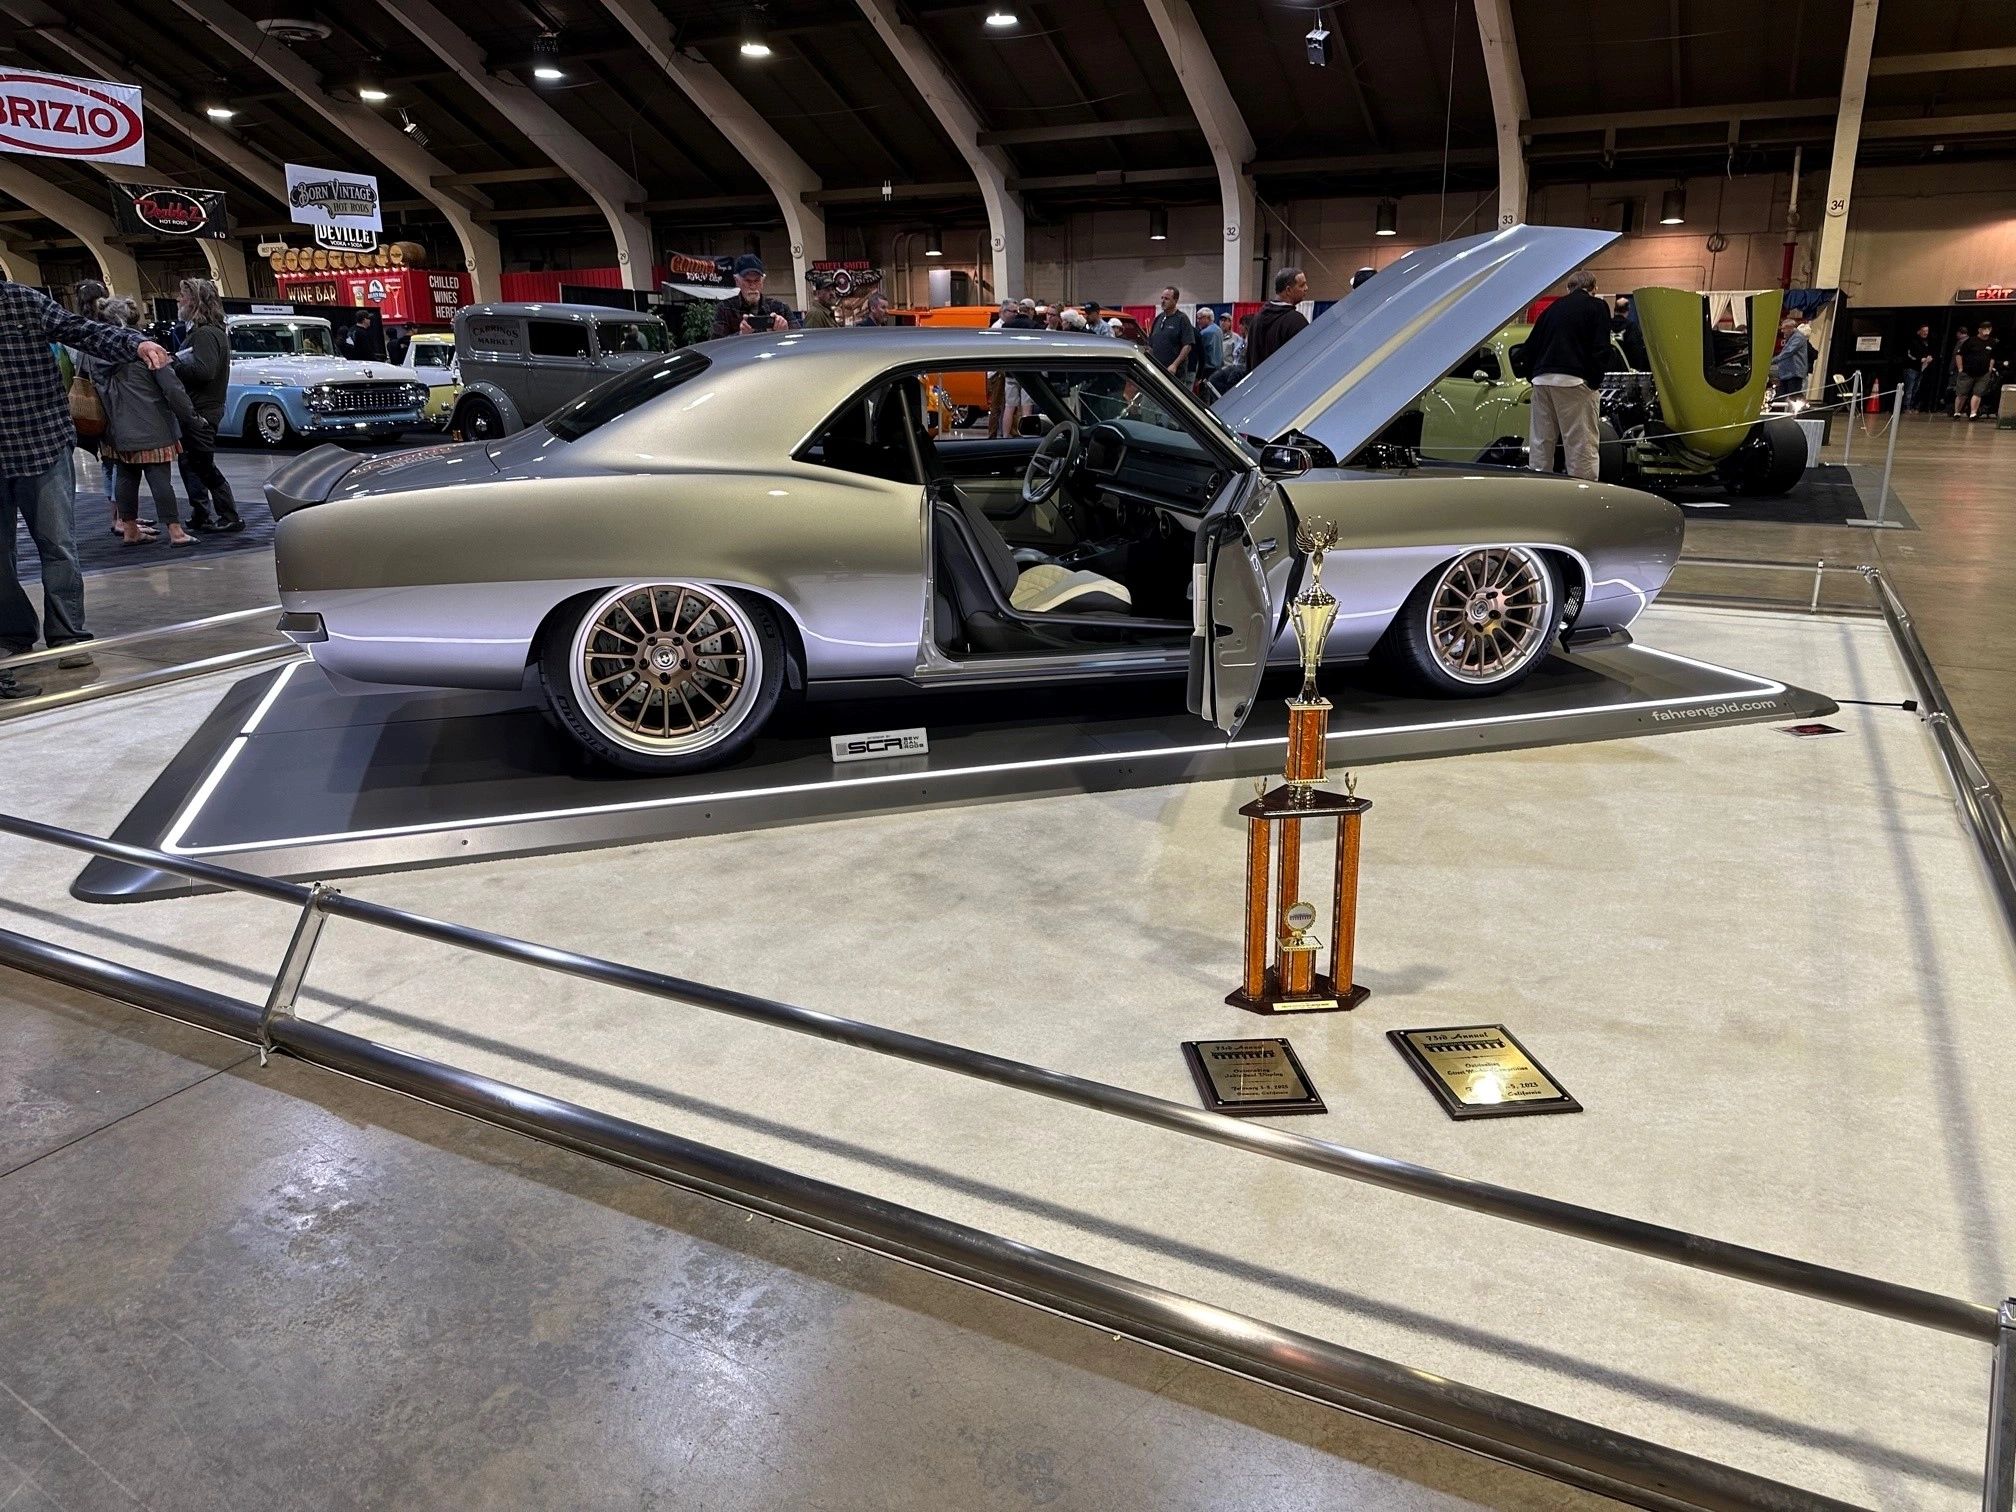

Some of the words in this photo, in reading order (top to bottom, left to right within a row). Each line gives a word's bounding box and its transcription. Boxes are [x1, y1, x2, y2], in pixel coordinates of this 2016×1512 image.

[0, 95, 118, 138] RIZIO
[298, 182, 328, 208] BORN
[328, 178, 373, 202] VINTAGE
[333, 202, 348, 212] HOT
[350, 202, 370, 213] RODS
[1830, 200, 1844, 210] 34
[1502, 215, 1513, 224] 33
[319, 224, 370, 243] DEVILLE
[1226, 228, 1235, 236] 32
[994, 238, 1001, 247] 31
[792, 245, 801, 253] 30
[619, 252, 627, 261] 29
[843, 261, 870, 269] SMITH
[429, 275, 460, 289] CHILLED
[286, 286, 313, 303] WINE
[315, 284, 337, 302] BAR
[433, 290, 458, 304] WINES
[1976, 289, 2014, 300] EXIT
[1651, 699, 1777, 721] fahrengold.com
